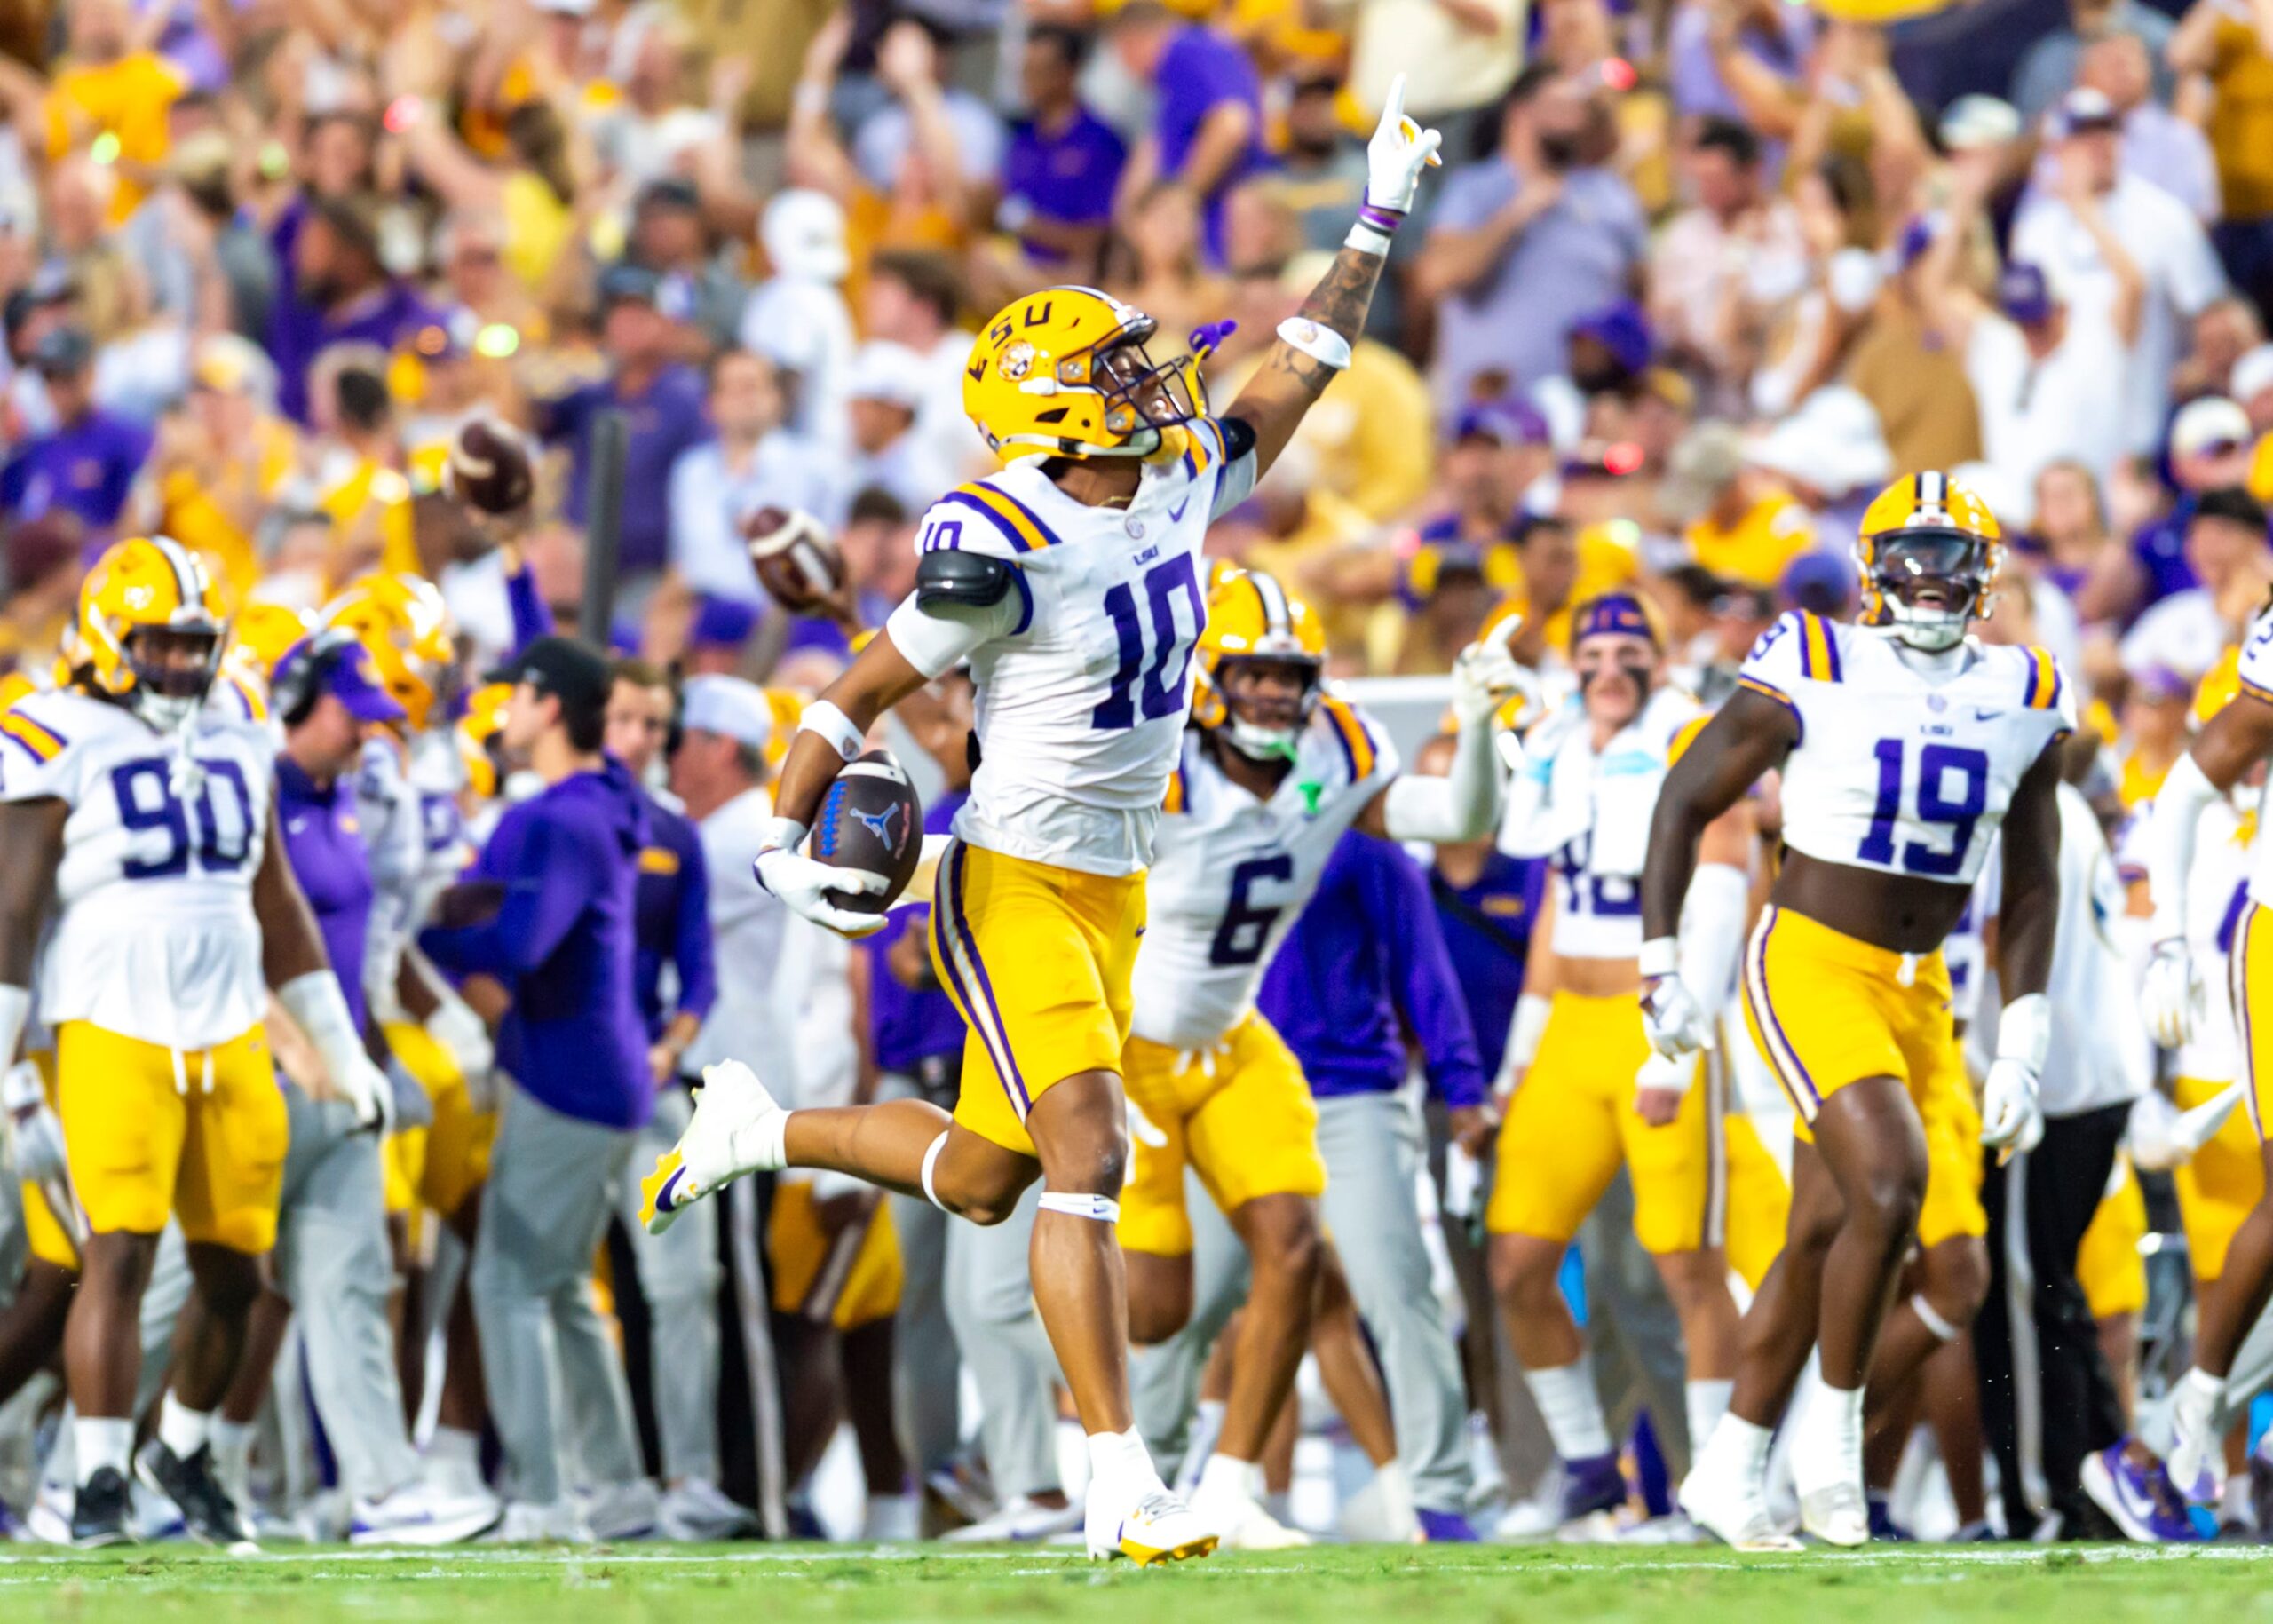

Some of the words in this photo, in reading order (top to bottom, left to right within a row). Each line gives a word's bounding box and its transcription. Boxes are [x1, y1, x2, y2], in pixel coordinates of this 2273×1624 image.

[968, 300, 1053, 383] LSU
[1133, 544, 1159, 566] LSU
[1092, 551, 1207, 729] 10
[112, 758, 254, 878] 90
[1857, 737, 1989, 875] 19
[1210, 854, 1293, 965] 6
